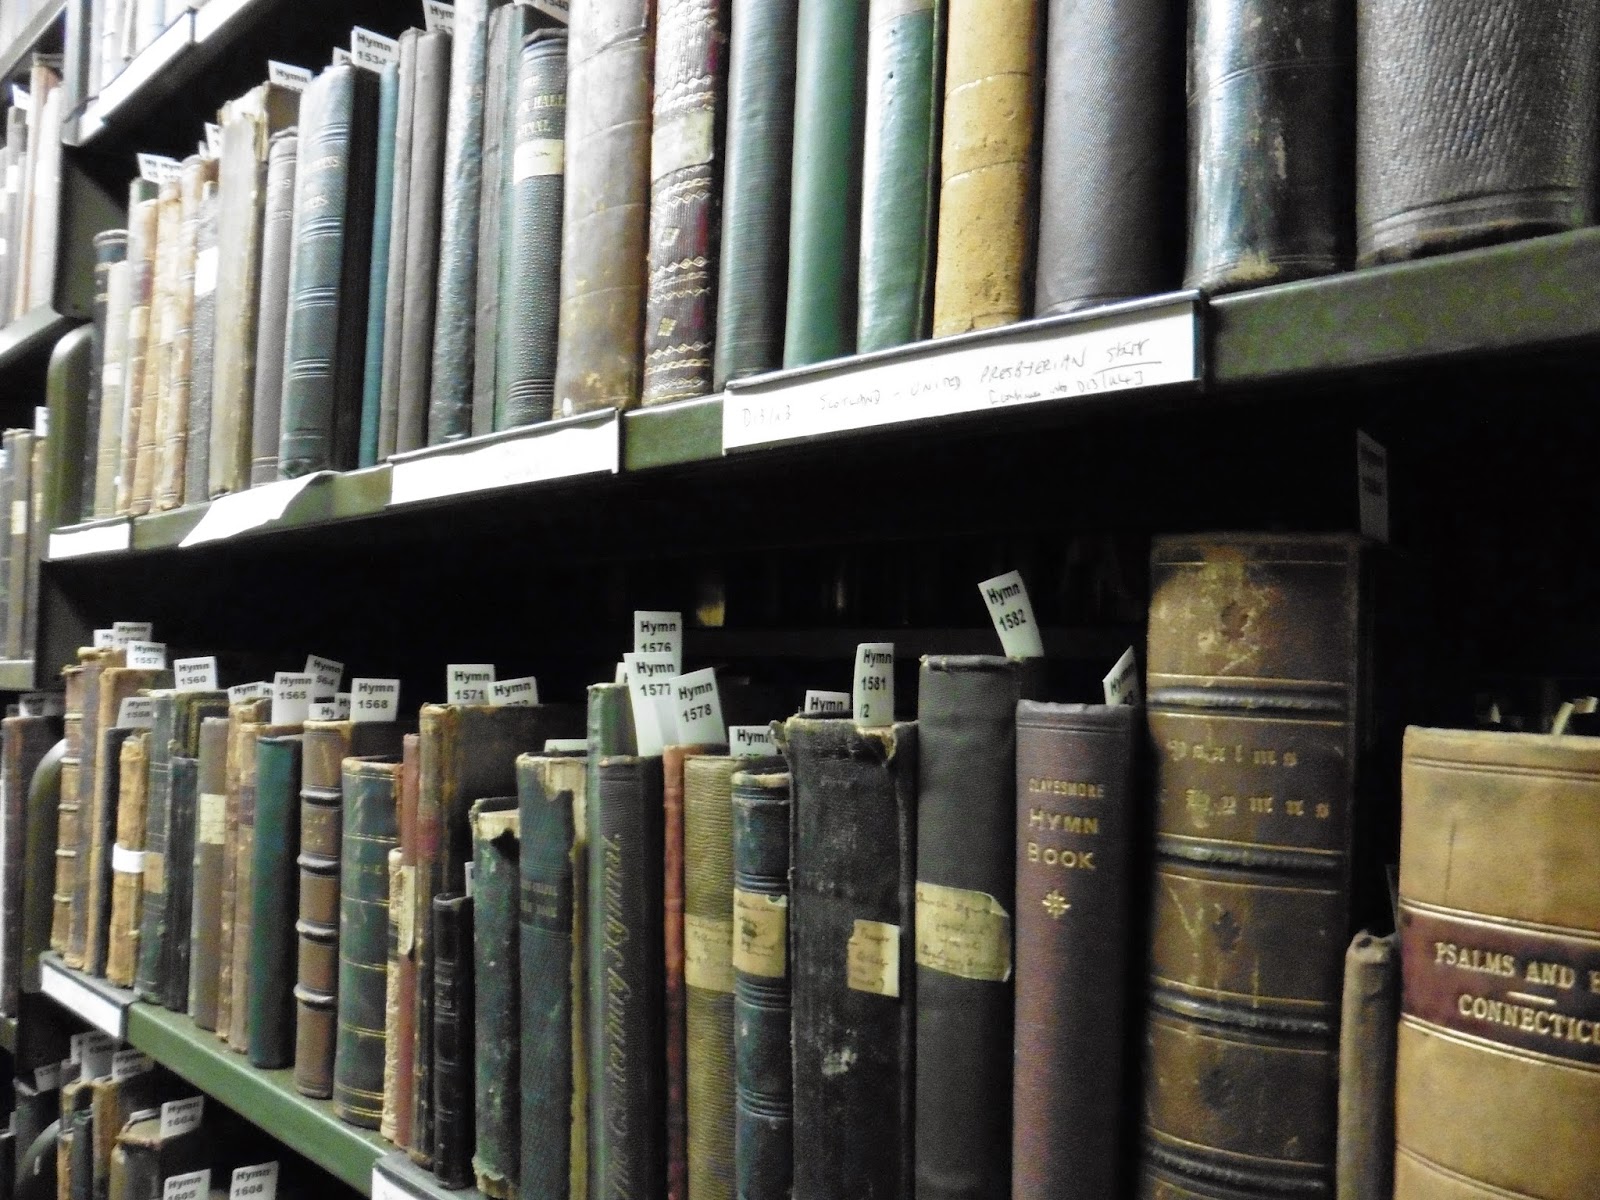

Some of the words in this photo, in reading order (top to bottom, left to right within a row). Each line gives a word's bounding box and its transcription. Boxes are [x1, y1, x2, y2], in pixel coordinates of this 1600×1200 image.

[356, 32, 393, 53] Hymn
[986, 582, 1020, 606] Hymn
[1000, 608, 1027, 632] 1582
[641, 620, 677, 636] Hymn
[641, 642, 672, 653] 1576
[863, 648, 892, 668] Hymn
[179, 663, 210, 673] Hymn
[636, 661, 675, 677] Hymn
[180, 675, 207, 685] 1560
[280, 677, 313, 690] Hymn
[455, 671, 490, 684] Hymn
[861, 676, 886, 691] 1581
[279, 691, 308, 700] 1565
[359, 683, 395, 695] Hymn
[454, 689, 484, 700] 1571
[494, 683, 531, 697] Hymn
[640, 682, 671, 696] 1577
[678, 682, 713, 701] Hymn
[358, 699, 389, 709] 1568
[810, 697, 844, 711] Hymn
[682, 703, 712, 722] 1578
[1028, 807, 1098, 834] HYMN
[1027, 841, 1096, 869] BOOK
[1434, 941, 1517, 978] PSALMS
[1525, 961, 1577, 989] AND
[236, 1169, 271, 1182] Hymn
[168, 1177, 202, 1190] Hymn
